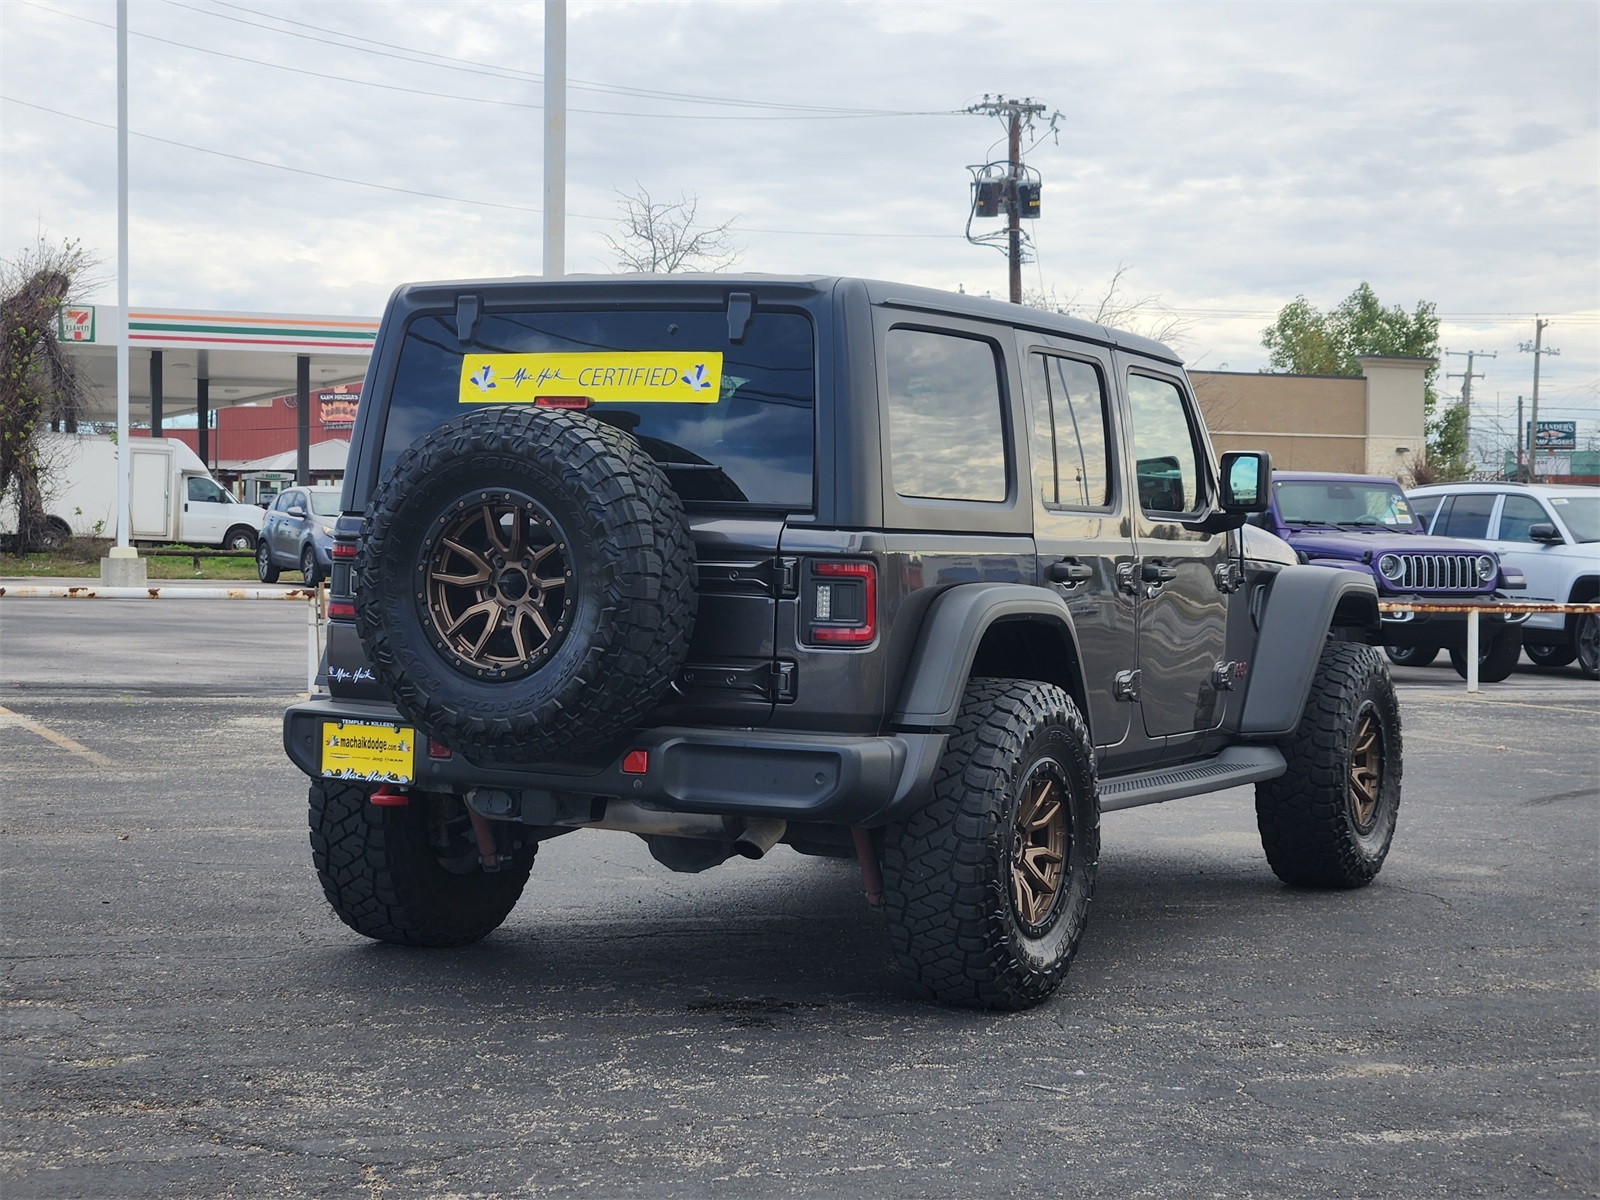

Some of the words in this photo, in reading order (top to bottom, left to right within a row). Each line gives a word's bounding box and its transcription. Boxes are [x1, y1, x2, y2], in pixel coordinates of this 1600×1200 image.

[578, 367, 679, 387] CERTIFIED
[469, 456, 572, 501] COUNTRY
[341, 718, 365, 726] TEMPLE
[340, 736, 397, 753] machaikdodge.com
